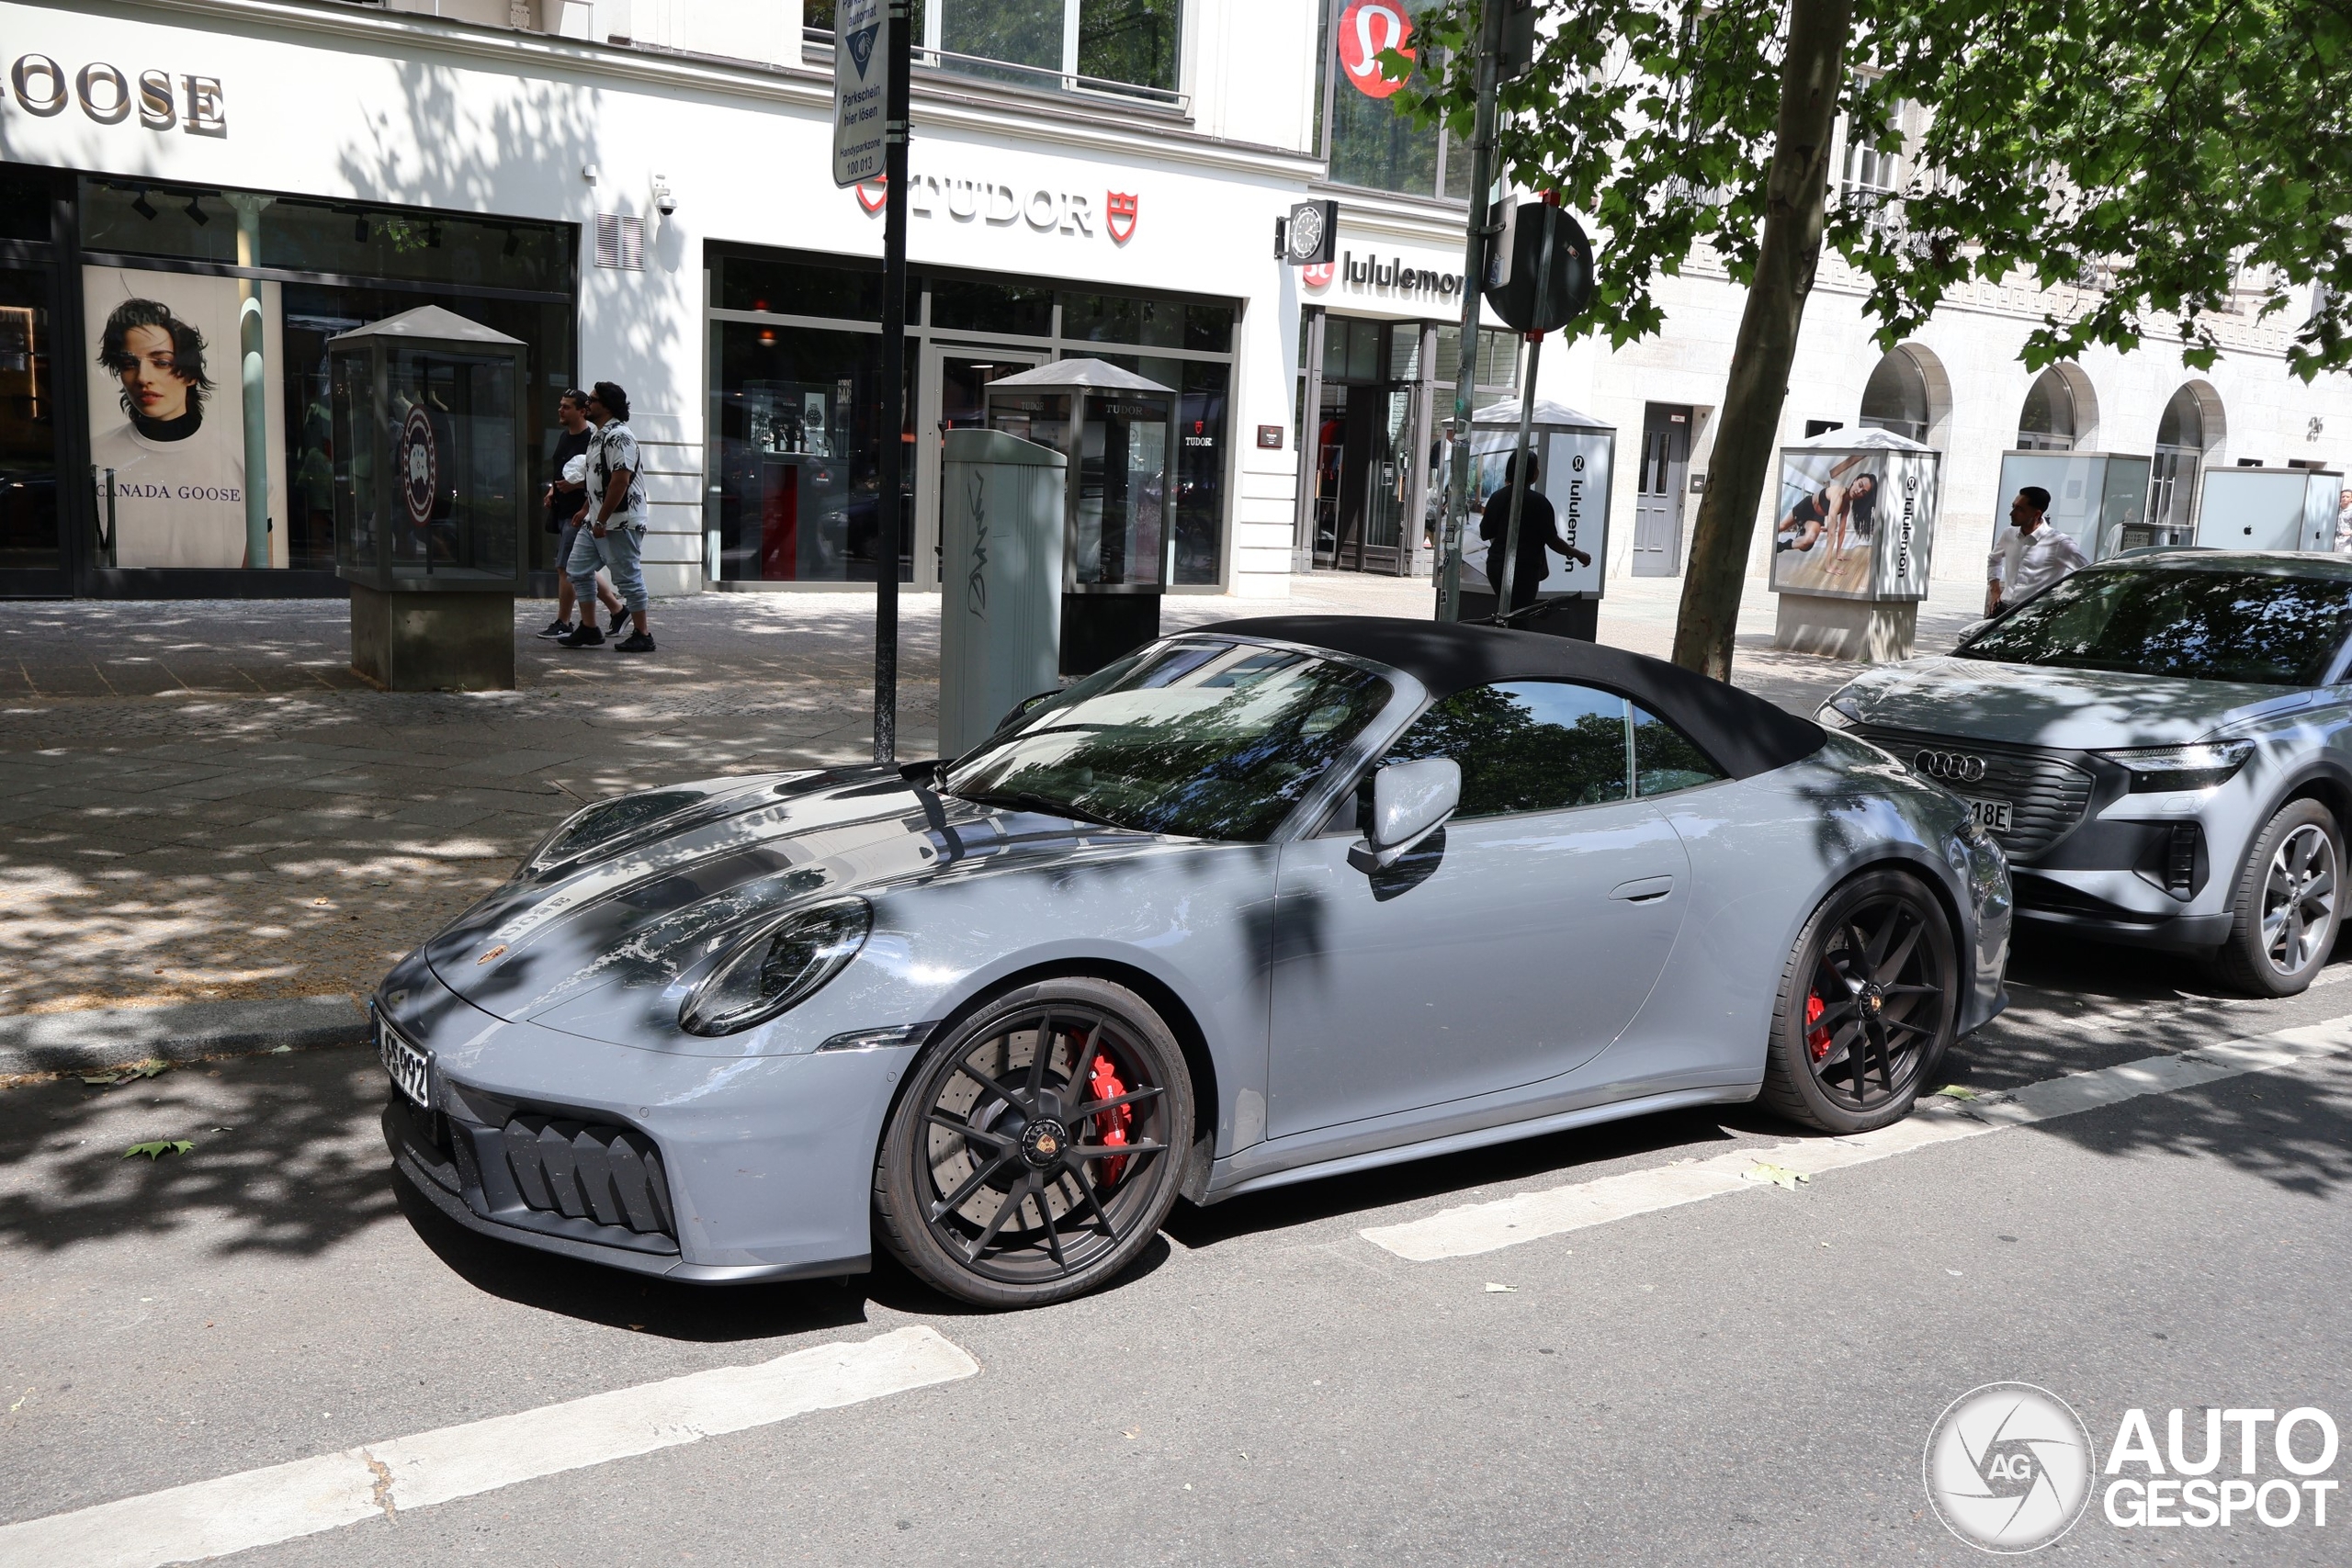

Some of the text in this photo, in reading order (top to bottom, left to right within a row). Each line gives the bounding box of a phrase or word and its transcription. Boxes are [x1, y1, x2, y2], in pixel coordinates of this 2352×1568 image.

[848, 5, 876, 27] automat
[0, 53, 226, 134] OOSE
[842, 84, 881, 108] Parkschein
[843, 105, 877, 127] hier lösen
[840, 138, 881, 159] Handyparkzone
[847, 156, 873, 175] 100 013
[906, 174, 1093, 237] TUDOR
[1021, 401, 1044, 411] TUDOR
[1105, 404, 1143, 415] TUDOR
[1185, 437, 1212, 446] TUDOR
[178, 486, 242, 502] GOOSE
[1564, 479, 1583, 572] lululemn
[1897, 497, 1915, 578] lululemon
[1968, 800, 2008, 829] 18E
[1107, 1085, 1122, 1139] POSCHE
